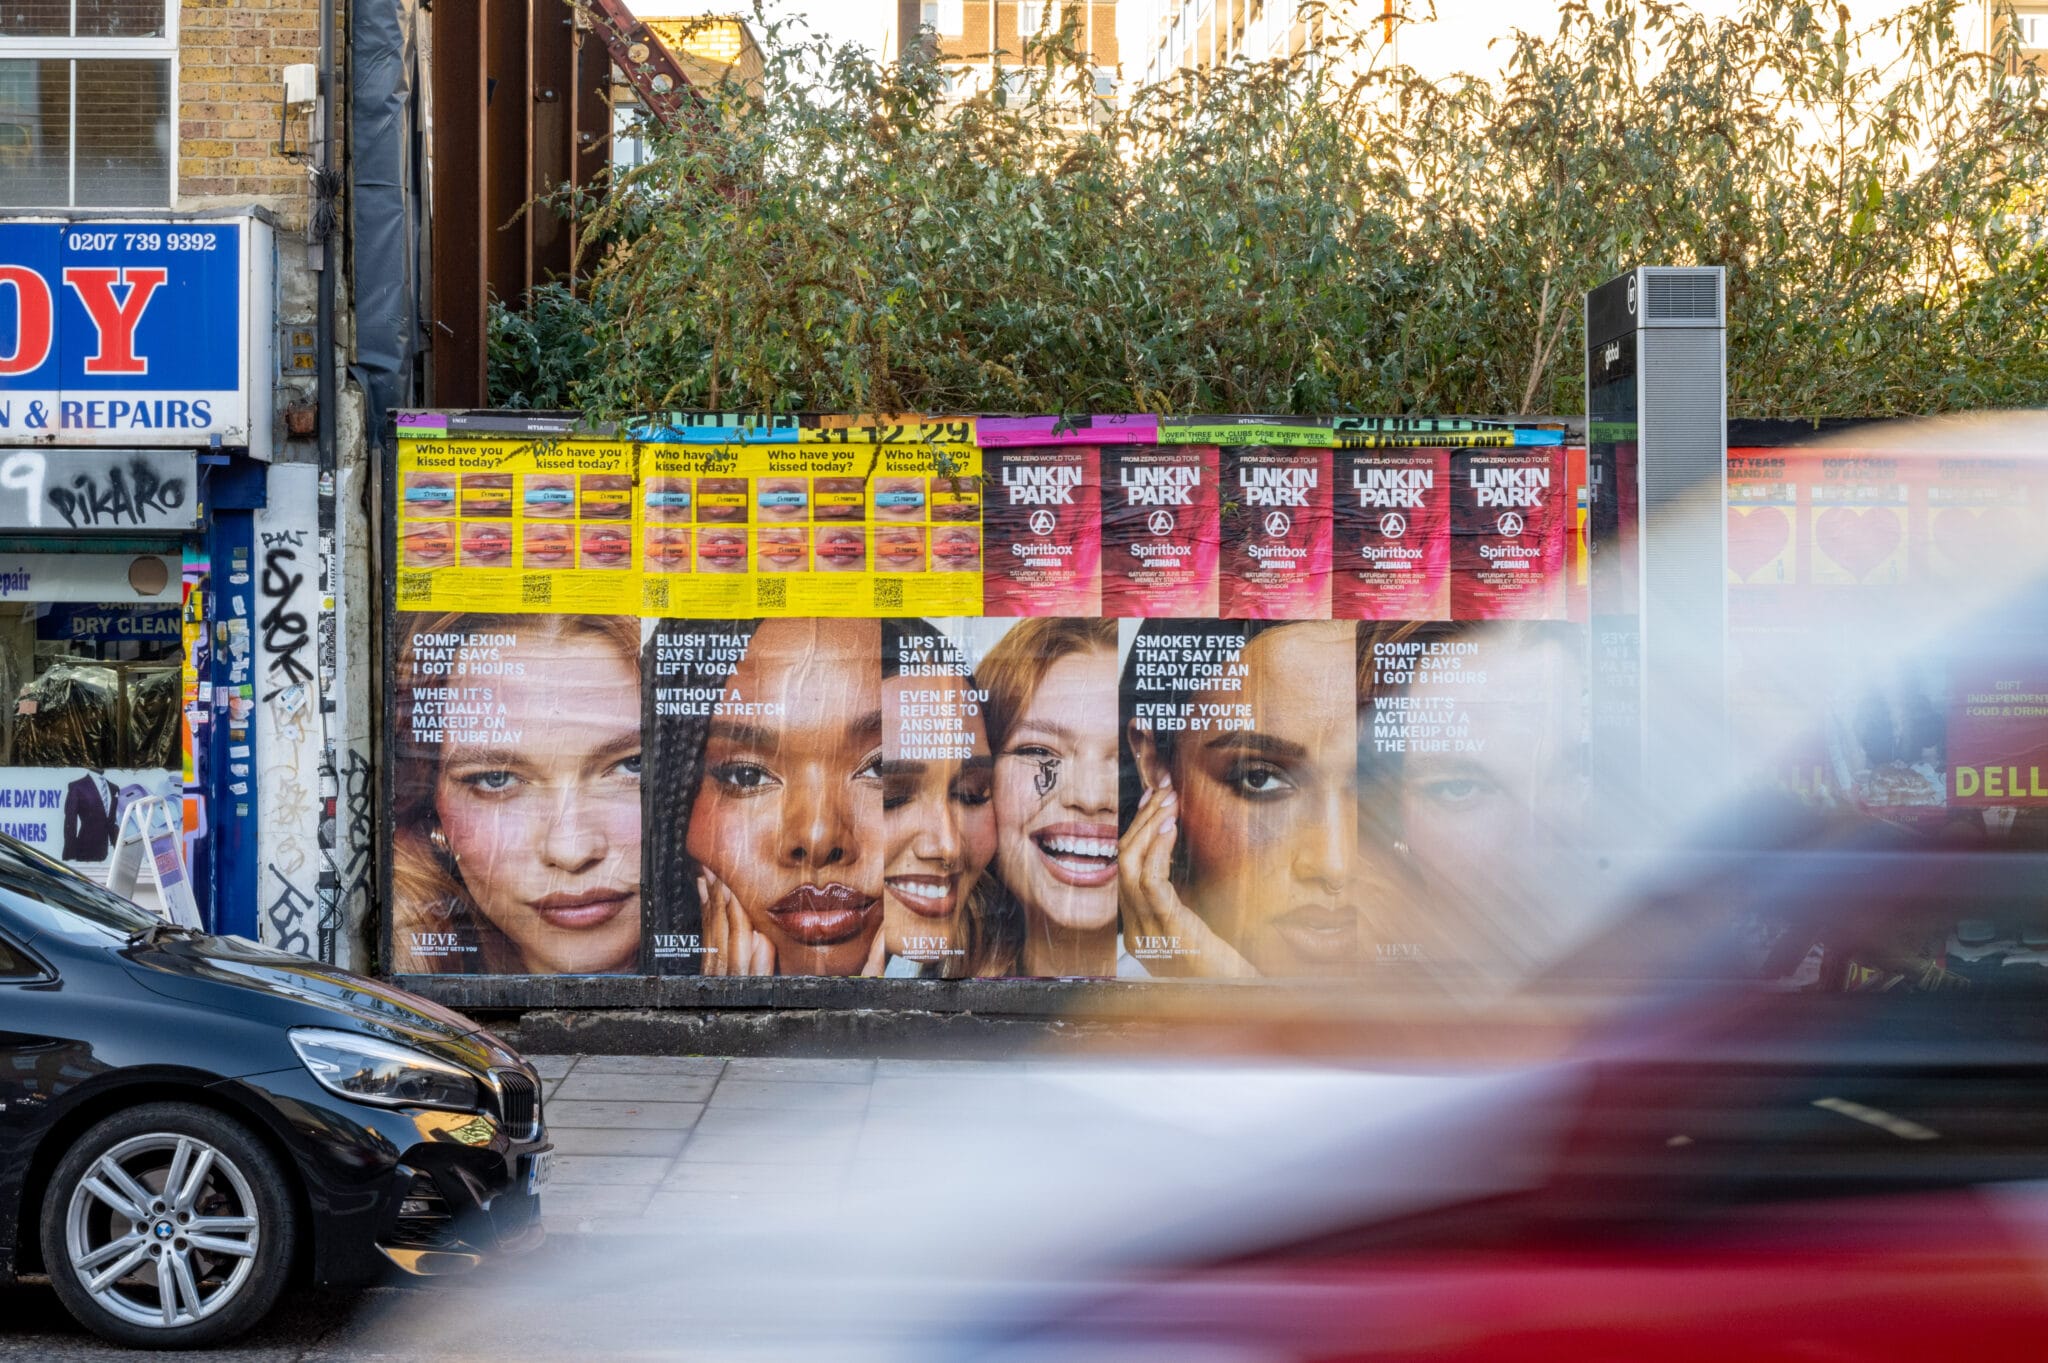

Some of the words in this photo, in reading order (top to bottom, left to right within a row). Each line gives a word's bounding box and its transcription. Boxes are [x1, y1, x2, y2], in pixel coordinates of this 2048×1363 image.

[69, 233, 118, 251] 0207
[124, 233, 161, 251] 739
[167, 233, 216, 251] 9392
[24, 400, 48, 429] &
[61, 400, 212, 429] REPAIRS
[416, 445, 444, 455] Who
[448, 445, 476, 455] have
[480, 448, 503, 458] you
[566, 447, 596, 457] have
[599, 451, 622, 461] you
[655, 450, 680, 460] Who
[768, 450, 796, 460] Who
[800, 450, 828, 460] have
[832, 452, 855, 463] you
[885, 450, 914, 460] Who
[417, 457, 456, 467] kissed
[460, 458, 503, 469] today?
[536, 459, 575, 469] kissed
[578, 459, 620, 471] today?
[655, 461, 691, 471] kissed
[769, 462, 808, 472] kissed
[811, 462, 853, 473] today?
[886, 461, 925, 471] kissed
[1748, 458, 1785, 467] YEARS
[1003, 466, 1082, 486] LINKIN
[1121, 467, 1200, 486] LINKIN
[1240, 468, 1317, 488] LINKIN
[1354, 469, 1433, 489] LINKIN
[1470, 468, 1549, 488] LINKIN
[1010, 486, 1074, 505] PARK
[1128, 486, 1193, 505] PARK
[1247, 487, 1309, 506] PARK
[1361, 488, 1425, 507] PARK
[1478, 488, 1542, 507] PARK
[1012, 544, 1072, 558] Spiritbox
[1131, 544, 1191, 558] Spiritbox
[1248, 545, 1307, 560] Spiritbox
[1362, 546, 1422, 561] Spiritbox
[1480, 545, 1540, 560] Spiritbox
[72, 617, 112, 634] DRY
[117, 617, 180, 634] CLEAN
[413, 634, 516, 647] COMPLEXION
[709, 634, 751, 647] THAT
[899, 636, 934, 649] LIPS
[1136, 635, 1202, 648] SMOKEY
[1206, 635, 1245, 648] EYES
[413, 648, 455, 660] THAT
[459, 648, 499, 660] SAYS
[656, 649, 694, 661] SAYS
[707, 649, 748, 661] JUST
[1374, 643, 1479, 655] COMPLEXION
[899, 650, 932, 663] SAY
[1136, 650, 1178, 662] THAT
[1182, 650, 1212, 662] SAY
[1217, 650, 1240, 662] I'M
[422, 663, 454, 675] GOT
[457, 663, 466, 675] 8
[470, 663, 525, 675] HOURS
[656, 663, 691, 675] LEFT
[694, 663, 738, 675] YOGA
[1136, 664, 1189, 676] READY
[1192, 664, 1223, 676] FOR
[1227, 664, 1249, 676] AN
[1374, 657, 1417, 670] THAT
[1420, 657, 1461, 670] SAYS
[899, 664, 972, 677] BUSINESS
[1136, 678, 1241, 690] ALL-NIGHTER
[1383, 671, 1415, 684] GOT
[1419, 671, 1428, 684] 8
[1432, 671, 1487, 684] HOURS
[413, 688, 459, 700] WHEN
[463, 688, 492, 700] IT'S
[656, 688, 727, 701] WITHOUT
[730, 688, 742, 701] A
[899, 690, 939, 702] EVEN
[944, 690, 956, 702] IF
[960, 690, 989, 702] YOU
[413, 702, 491, 714] ACTUALLY
[498, 702, 507, 714] A
[655, 703, 709, 715] SINGLE
[713, 703, 786, 715] STRETCH
[900, 704, 956, 716] REFUSE
[961, 704, 978, 716] TO
[1136, 703, 1176, 716] EVEN
[1180, 703, 1195, 716] IF
[1199, 703, 1252, 716] YOU'RE
[1374, 697, 1420, 710] WHEN
[1425, 697, 1454, 710] IT'S
[413, 716, 478, 728] MAKEUP
[484, 716, 505, 728] ON
[1136, 718, 1152, 730] IN
[1156, 718, 1186, 730] BED
[1191, 718, 1211, 730] BY
[1215, 718, 1255, 730] 10PM
[1374, 711, 1455, 724] ACTUALLY
[1458, 711, 1470, 724] A
[900, 718, 963, 731] ANSWER
[413, 730, 443, 743] THE
[448, 730, 488, 743] TUBE
[492, 730, 522, 743] DAY
[1374, 725, 1441, 738] MAKEUP
[1446, 725, 1468, 738] ON
[900, 733, 975, 745] UNKNOWN
[900, 747, 972, 759] NUMBERS
[15, 789, 36, 808] DAY
[39, 789, 62, 808] DRY
[410, 933, 457, 946] VIEVE
[654, 935, 699, 947] VIEVE
[902, 937, 947, 949] VIEVE
[1135, 936, 1181, 948] VIEVE
